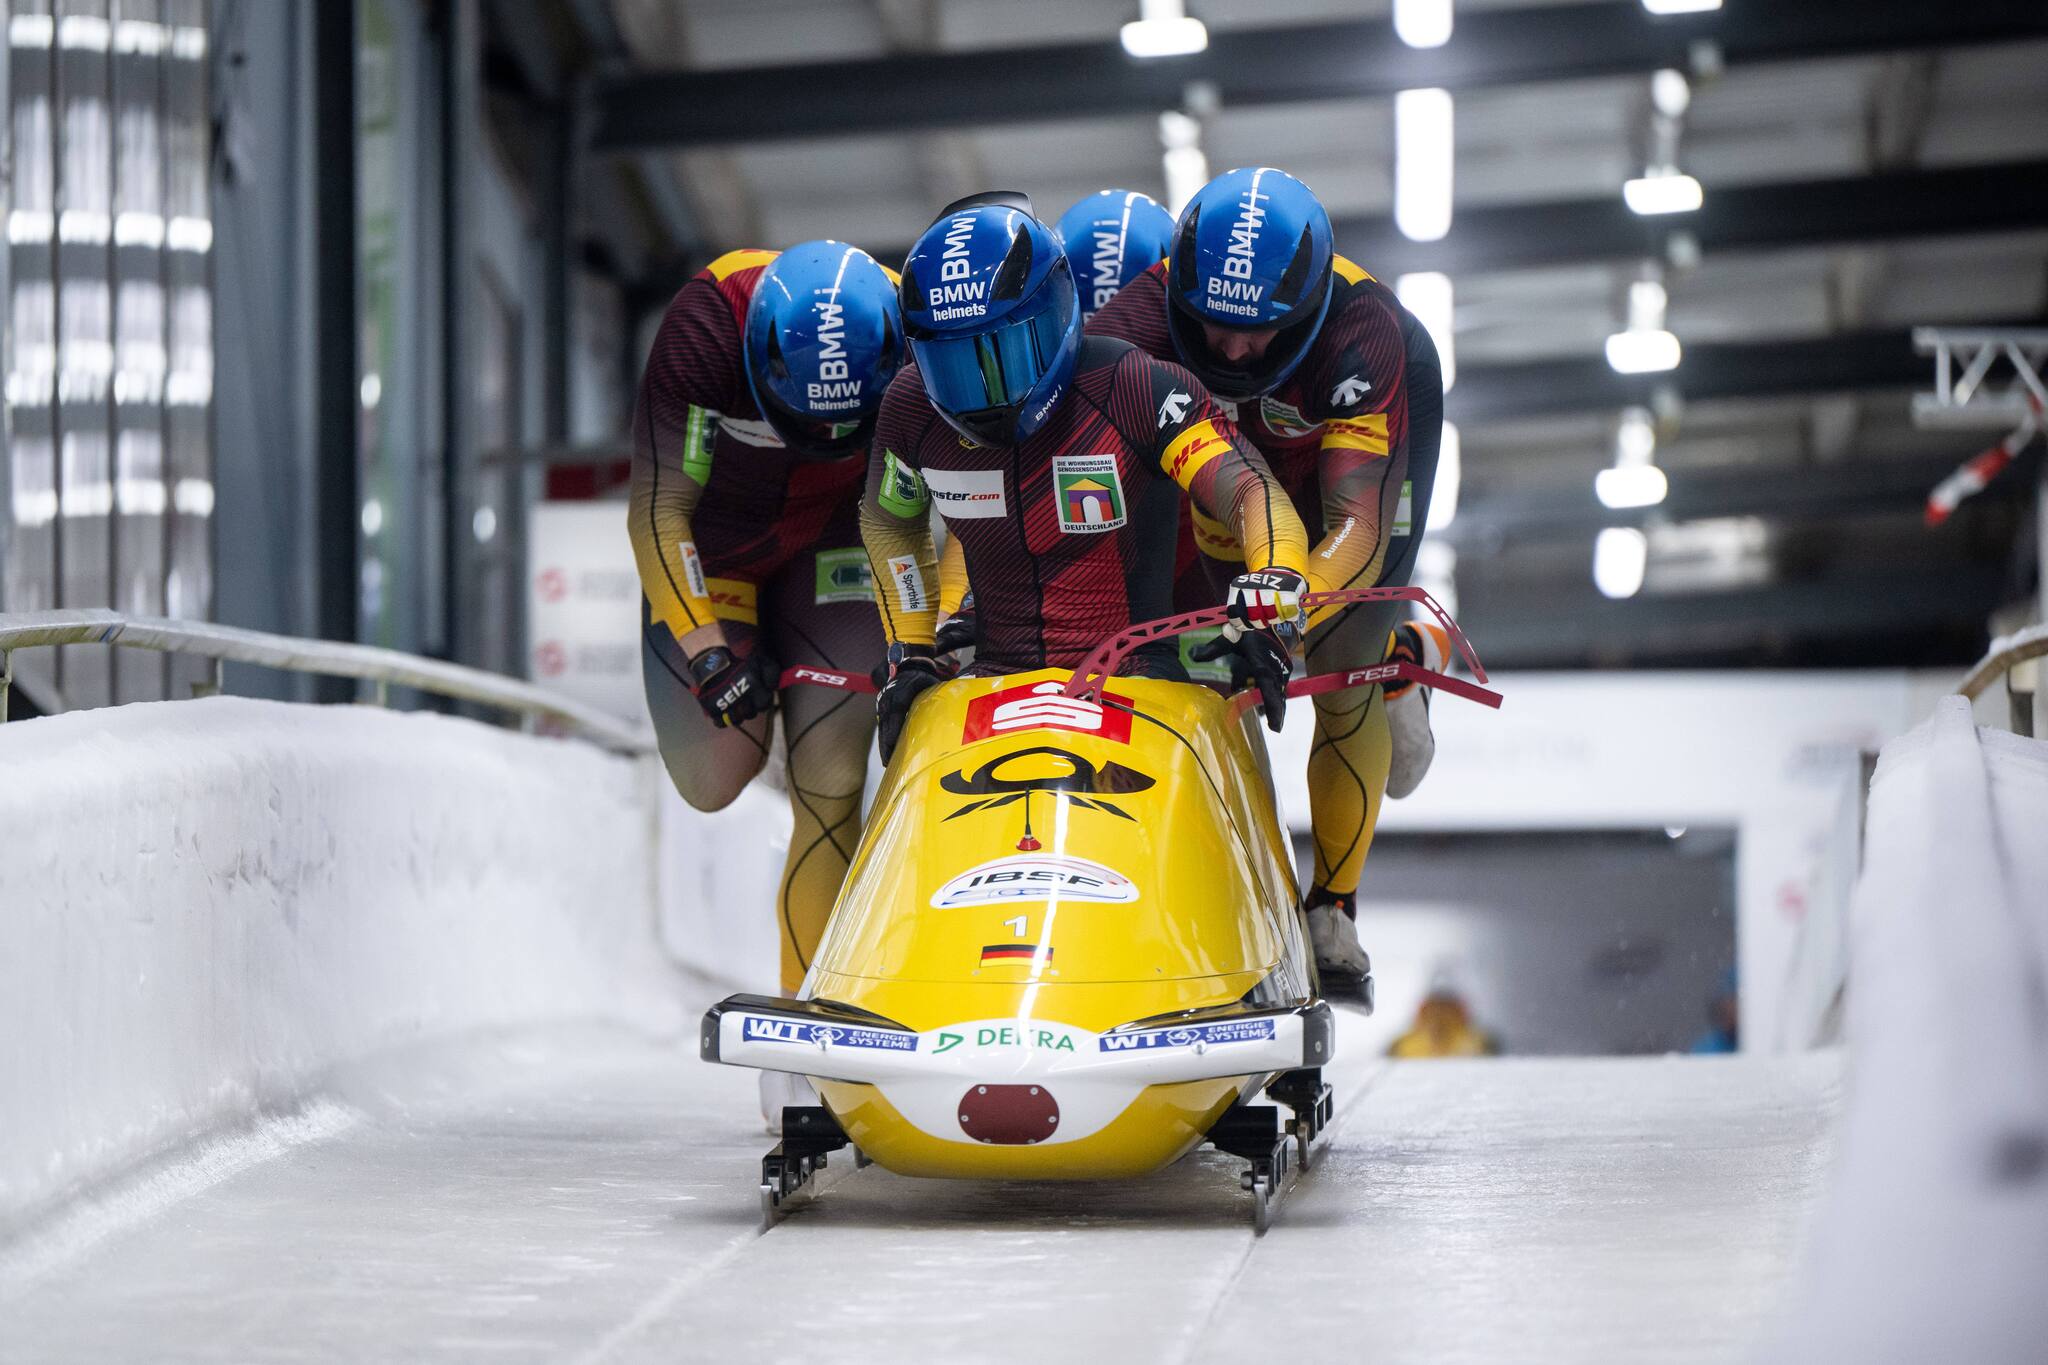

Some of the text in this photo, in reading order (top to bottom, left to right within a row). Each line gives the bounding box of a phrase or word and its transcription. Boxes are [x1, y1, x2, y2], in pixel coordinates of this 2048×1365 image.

[941, 217, 977, 282] BMW
[1224, 202, 1265, 280] BMW
[1093, 231, 1120, 309] BMW
[929, 281, 986, 306] BMW
[1207, 276, 1264, 303] BMW
[932, 303, 987, 322] helmets
[1207, 296, 1259, 317] helmets
[815, 302, 849, 381] BMW
[807, 380, 862, 398] BMW
[809, 398, 861, 411] helmets
[1035, 389, 1058, 421] BMW
[1068, 459, 1112, 467] WOHNUNGSBAU
[1064, 519, 1124, 531] DEUTSCHLAND
[1237, 573, 1283, 590] SEIZ
[795, 669, 848, 686] FES
[1347, 664, 1400, 685] FES
[716, 677, 750, 711] SEIZ
[969, 871, 1104, 888] IBSF
[1003, 915, 1029, 937] 1
[750, 1018, 912, 1043] WT ENERGIE
[1105, 1021, 1266, 1050] WT ENERGIE
[1206, 1028, 1270, 1043] SYSTEME
[849, 1036, 913, 1050] SYSTEME
